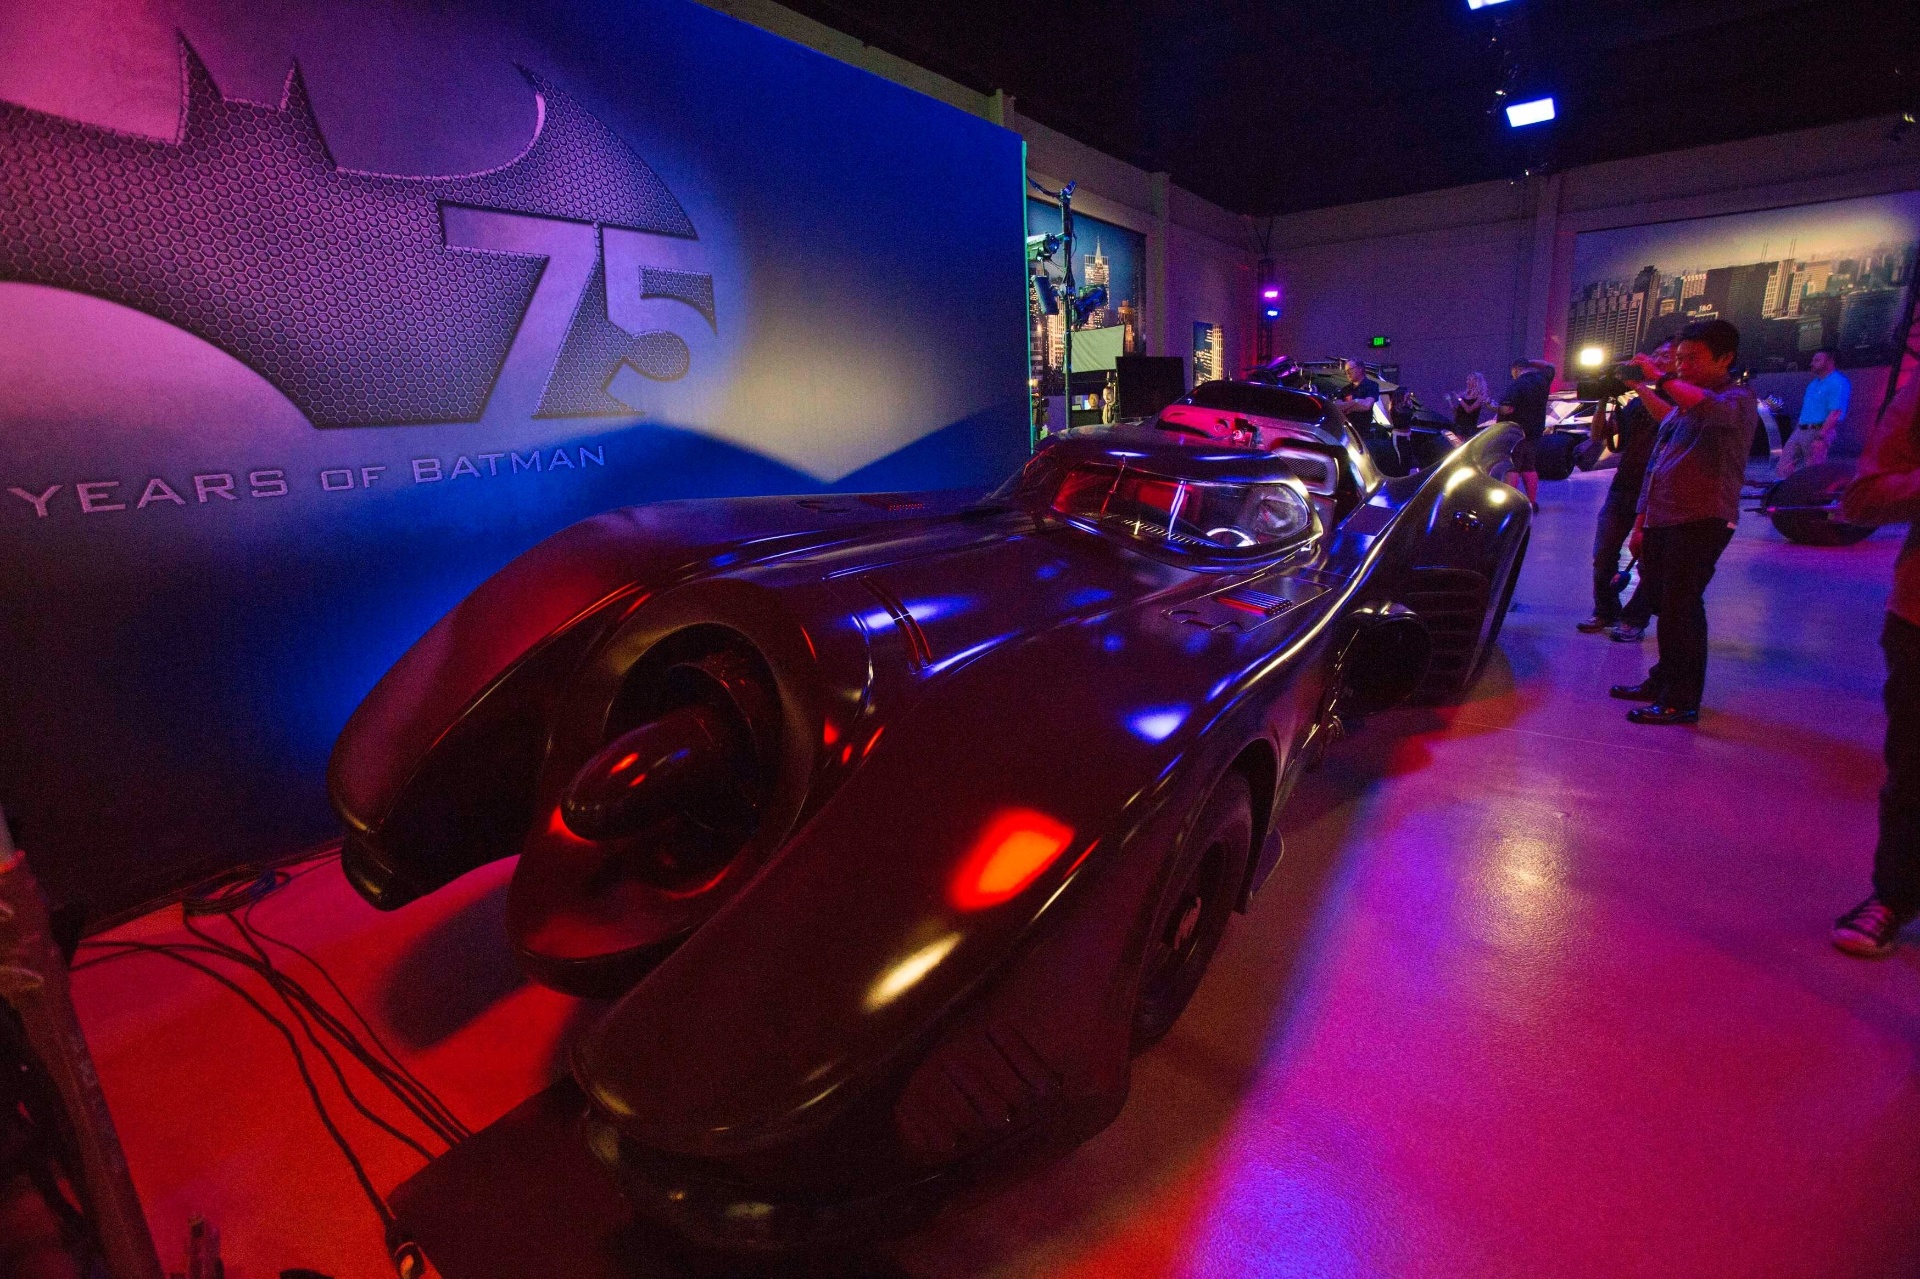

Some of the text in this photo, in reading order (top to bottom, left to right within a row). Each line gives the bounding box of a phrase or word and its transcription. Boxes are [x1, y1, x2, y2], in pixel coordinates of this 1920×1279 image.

[439, 203, 720, 423] 75
[6, 445, 606, 518] YEARS OF BATMAN
